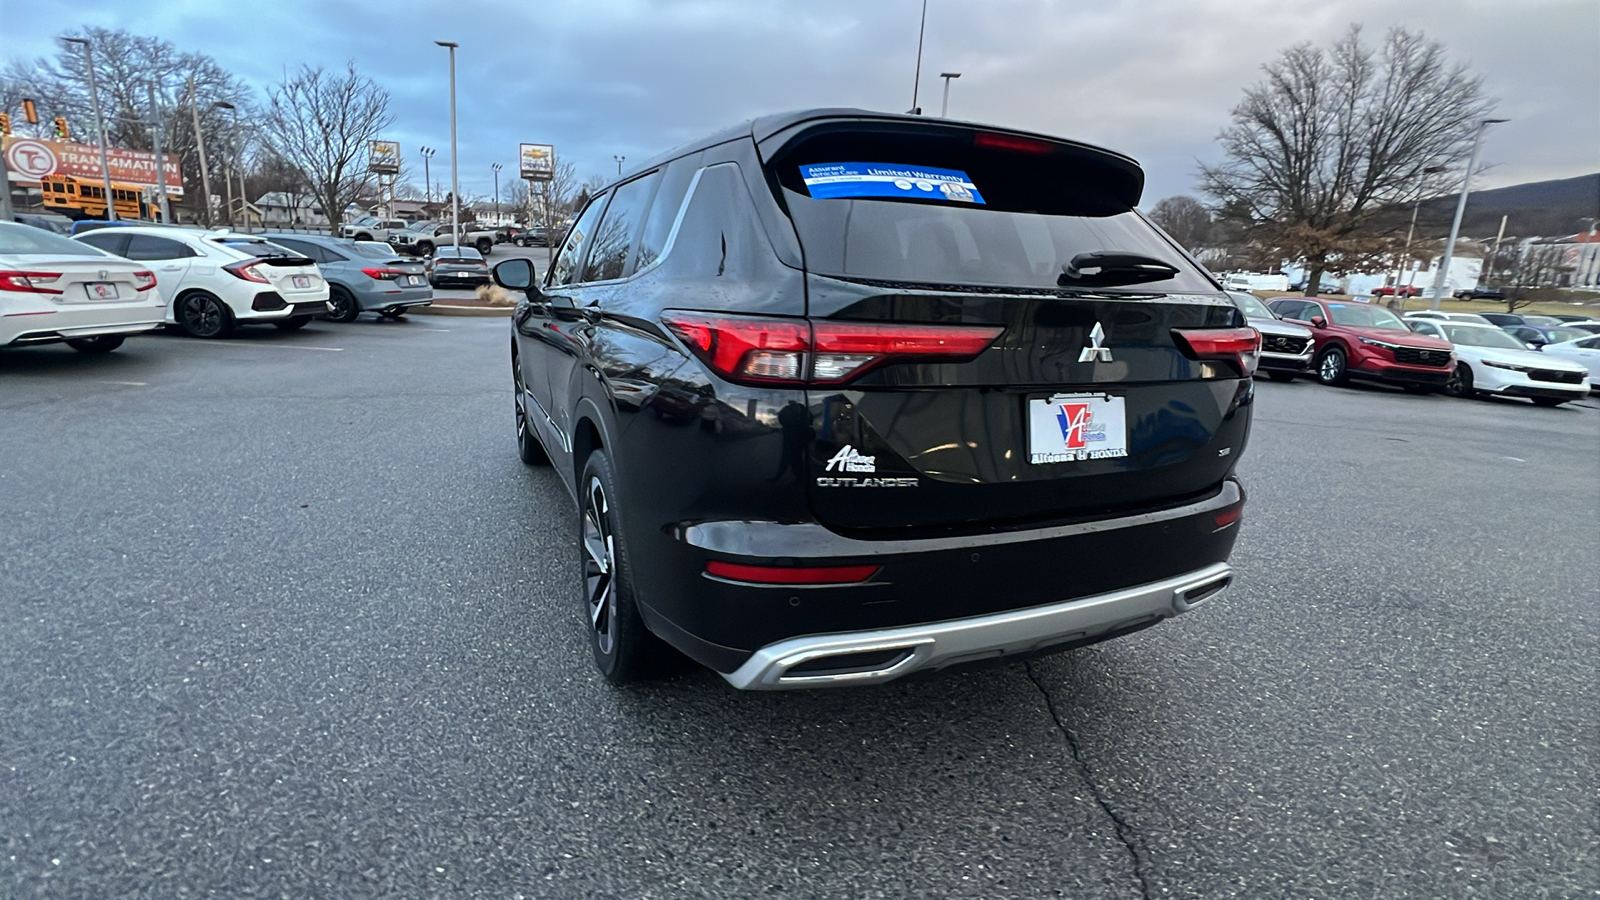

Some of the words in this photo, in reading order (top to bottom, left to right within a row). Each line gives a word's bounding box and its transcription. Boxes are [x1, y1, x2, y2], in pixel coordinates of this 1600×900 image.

[808, 165, 845, 173] Assurant
[867, 168, 911, 177] Limited
[911, 171, 964, 183] Warranty
[1031, 453, 1075, 464] Altoona
[1090, 449, 1128, 459] HONDA
[816, 477, 919, 488] OUTLANDER
